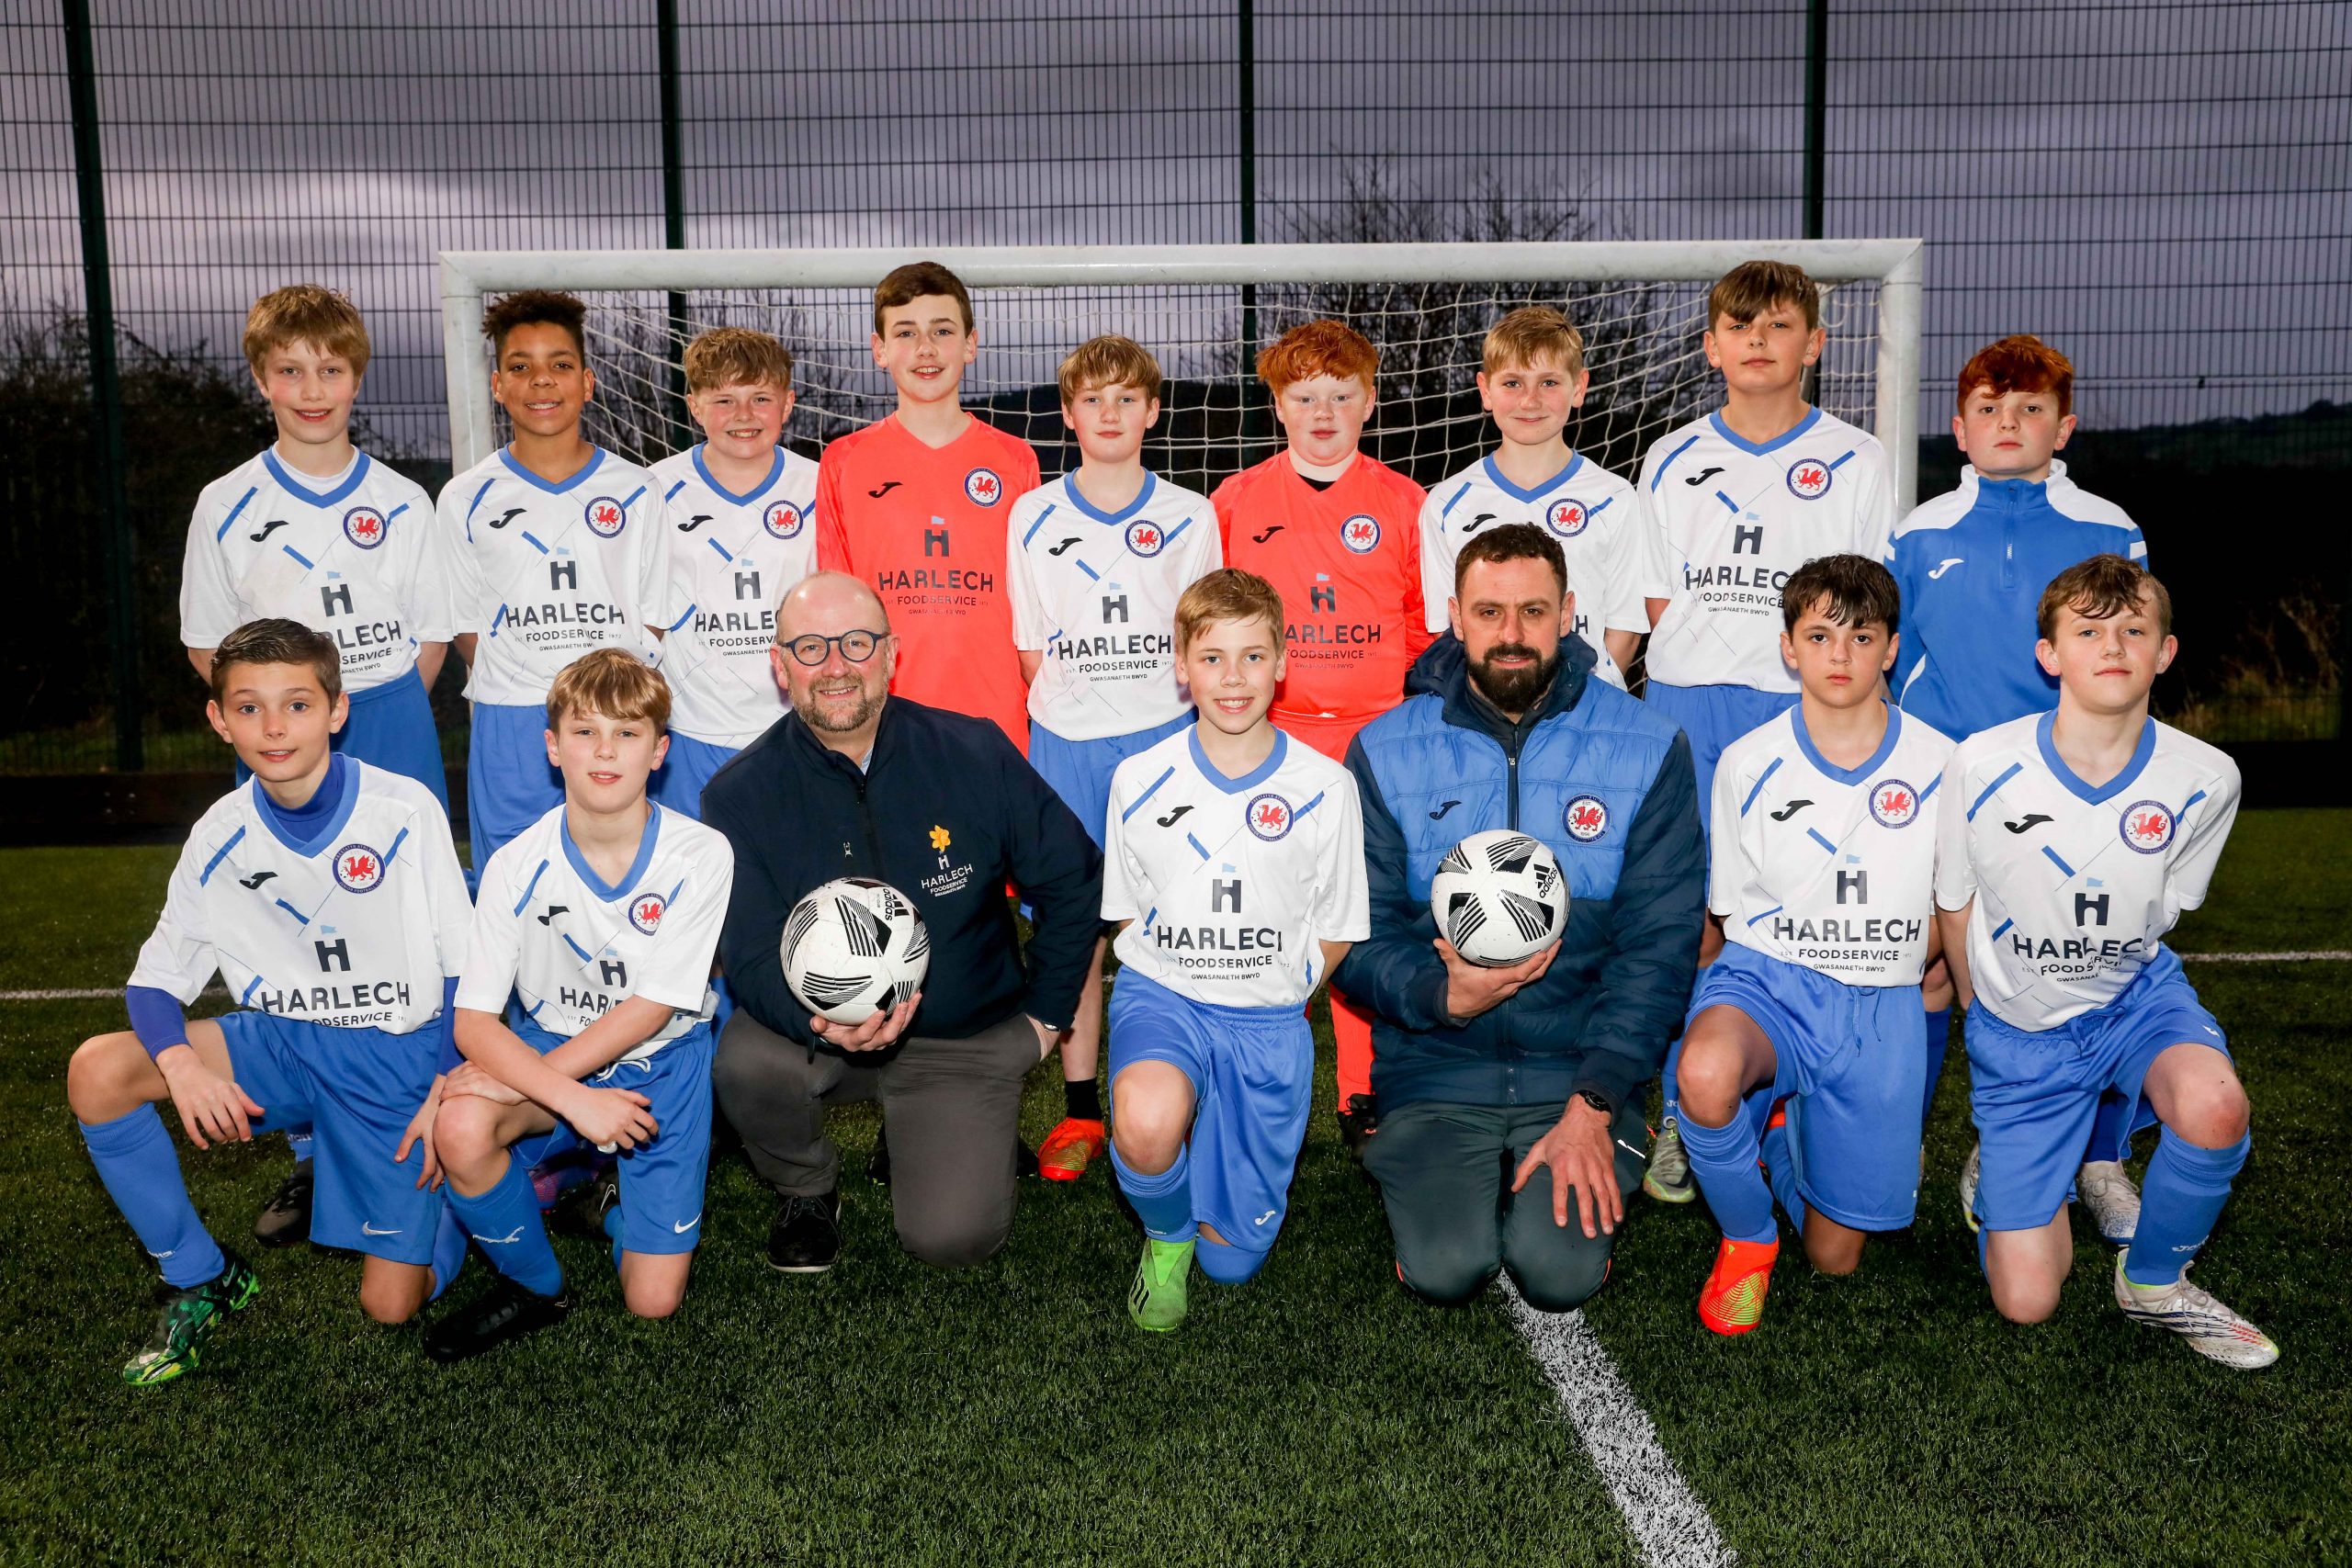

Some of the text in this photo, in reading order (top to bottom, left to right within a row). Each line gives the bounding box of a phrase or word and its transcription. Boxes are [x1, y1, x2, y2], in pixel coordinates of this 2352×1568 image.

[878, 570, 993, 592] HARLECH
[1685, 566, 1792, 592] HARLEC
[898, 595, 977, 606] FOODSERVICE
[1699, 592, 1784, 608] OODSERVICE
[505, 604, 625, 628] HARLECH
[695, 611, 774, 632] HARLE
[709, 636, 775, 647] FOODSERV
[1284, 625, 1380, 643] ARLECH
[342, 648, 392, 665] SERVICE
[1058, 635, 1170, 660] HARLECH
[1079, 660, 1158, 673] FOODSERVICE
[921, 863, 973, 889] HARLECH
[930, 877, 967, 894] FOODSERVICE
[1539, 867, 1558, 898] adidas
[883, 888, 895, 920] adidas
[1774, 917, 1921, 942] HARLECH
[1799, 949, 1899, 961] FOODSERVICE
[2013, 933, 2144, 960] HARLEC
[1179, 955, 1272, 969] FOODSERVICE
[1814, 964, 1864, 972] GWASANAETH
[2057, 974, 2099, 982] GWASANAE
[261, 981, 410, 1013] HARLECH
